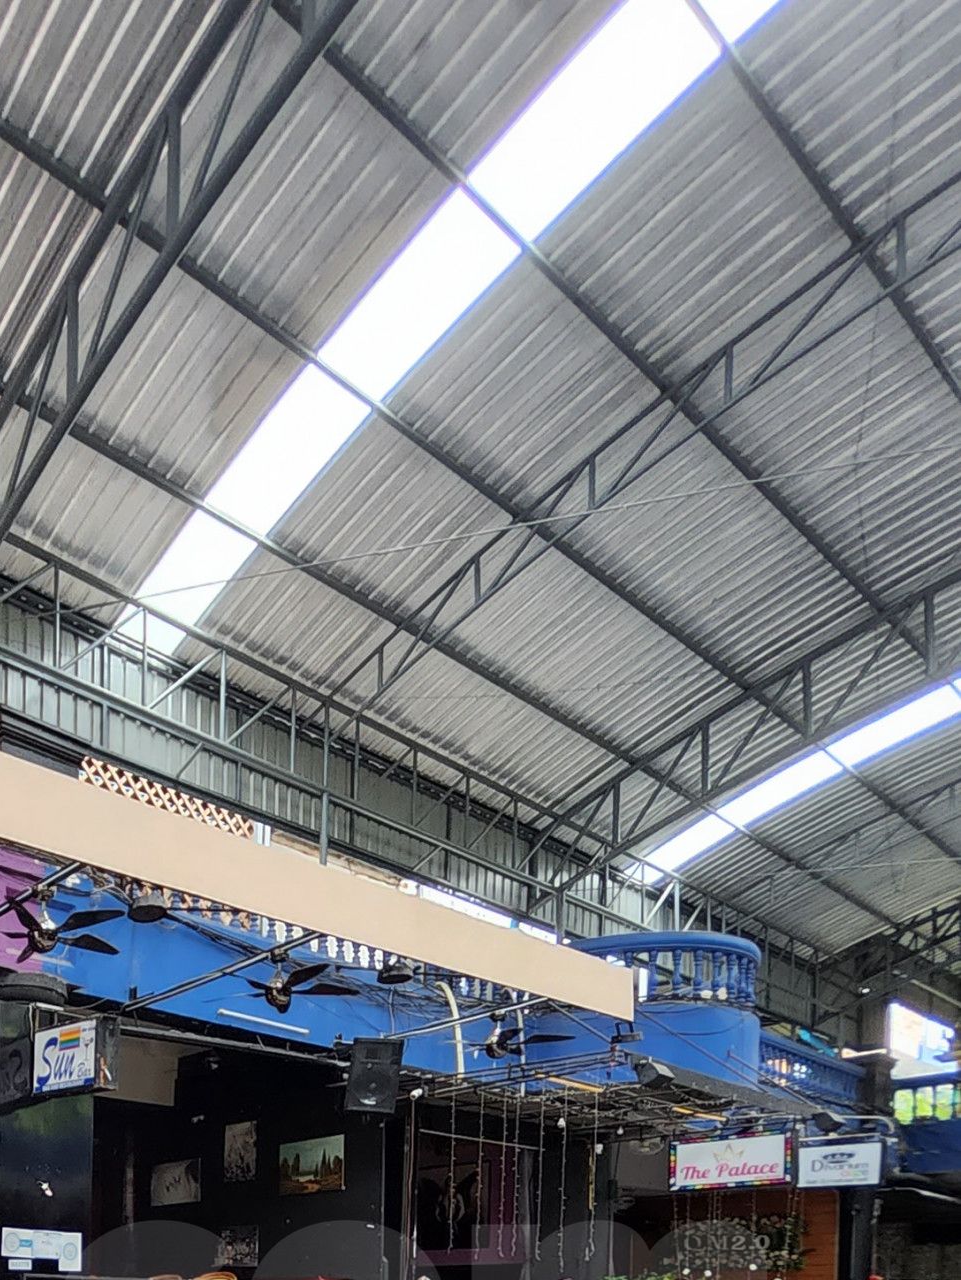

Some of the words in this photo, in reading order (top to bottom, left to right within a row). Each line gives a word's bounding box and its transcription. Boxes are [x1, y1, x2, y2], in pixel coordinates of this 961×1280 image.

[37, 1037, 75, 1085] Sun
[681, 1166, 710, 1180] The
[716, 1162, 779, 1177] Palace
